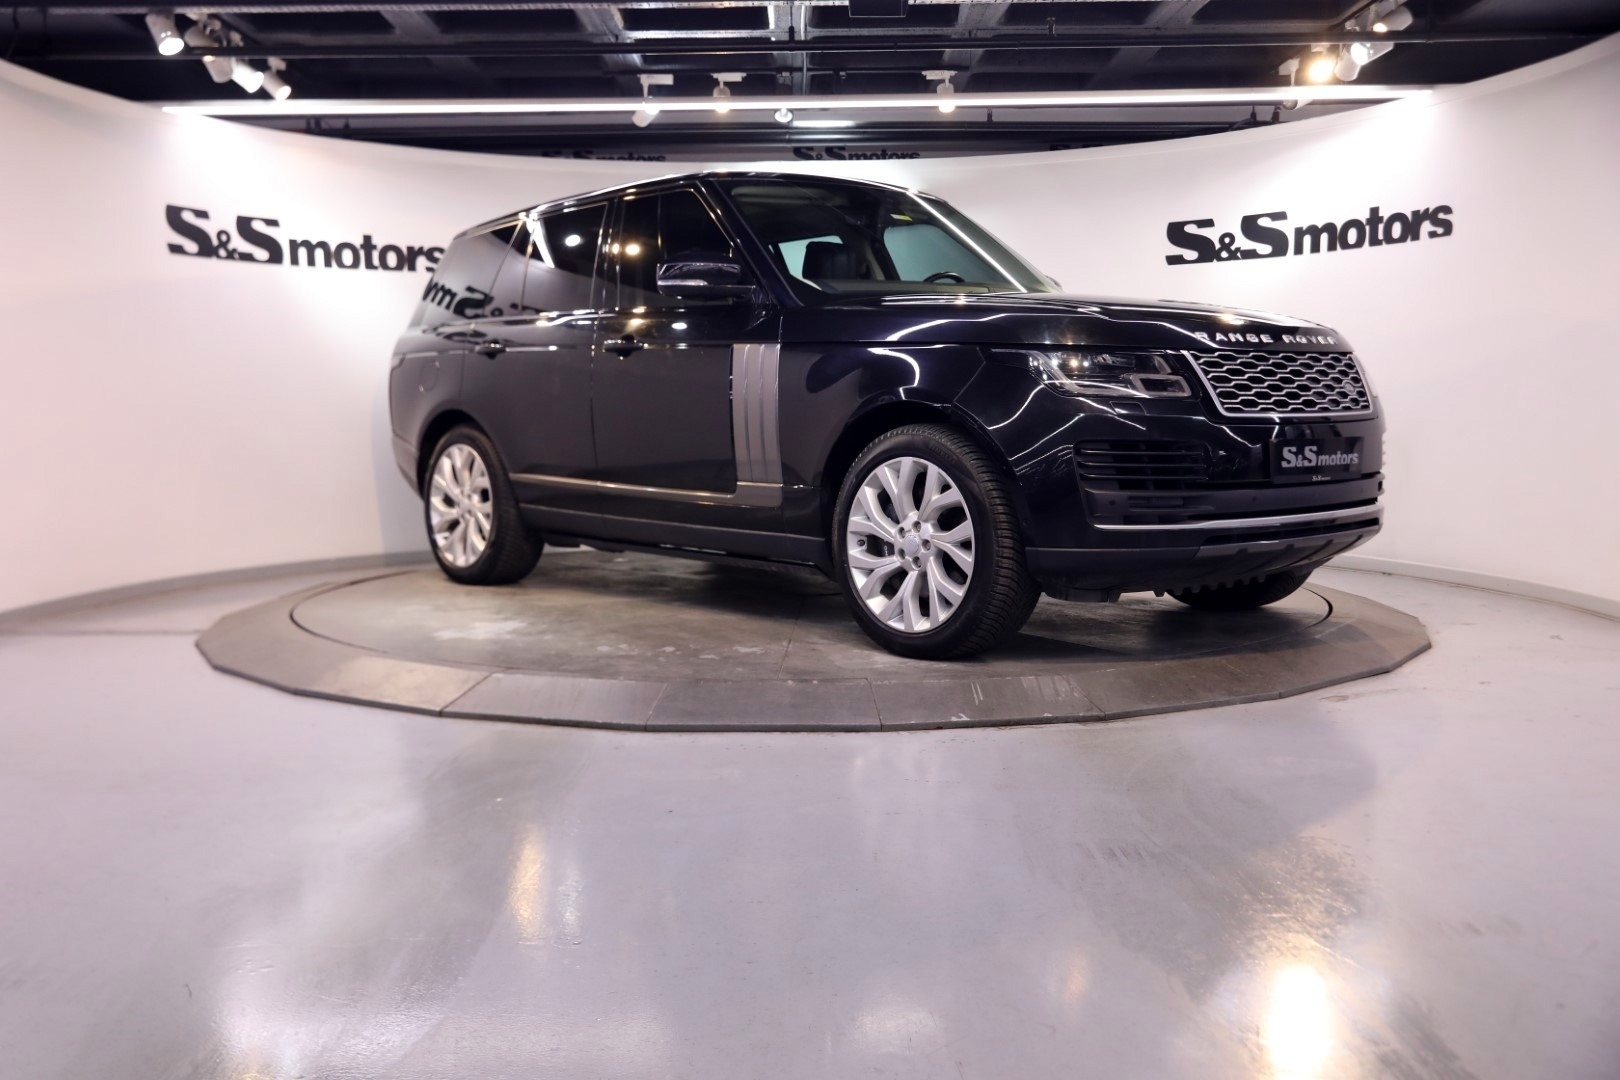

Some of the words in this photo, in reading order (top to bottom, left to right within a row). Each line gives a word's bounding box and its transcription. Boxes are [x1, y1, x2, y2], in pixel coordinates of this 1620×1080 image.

[166, 205, 283, 265] S&S
[289, 235, 446, 273] motors
[1165, 211, 1289, 265] S&S
[1293, 205, 1453, 256] motors
[1194, 332, 1274, 343] RANGE
[1282, 335, 1338, 345] ROVER
[1281, 445, 1317, 468] S&S
[1317, 450, 1360, 466] motors
